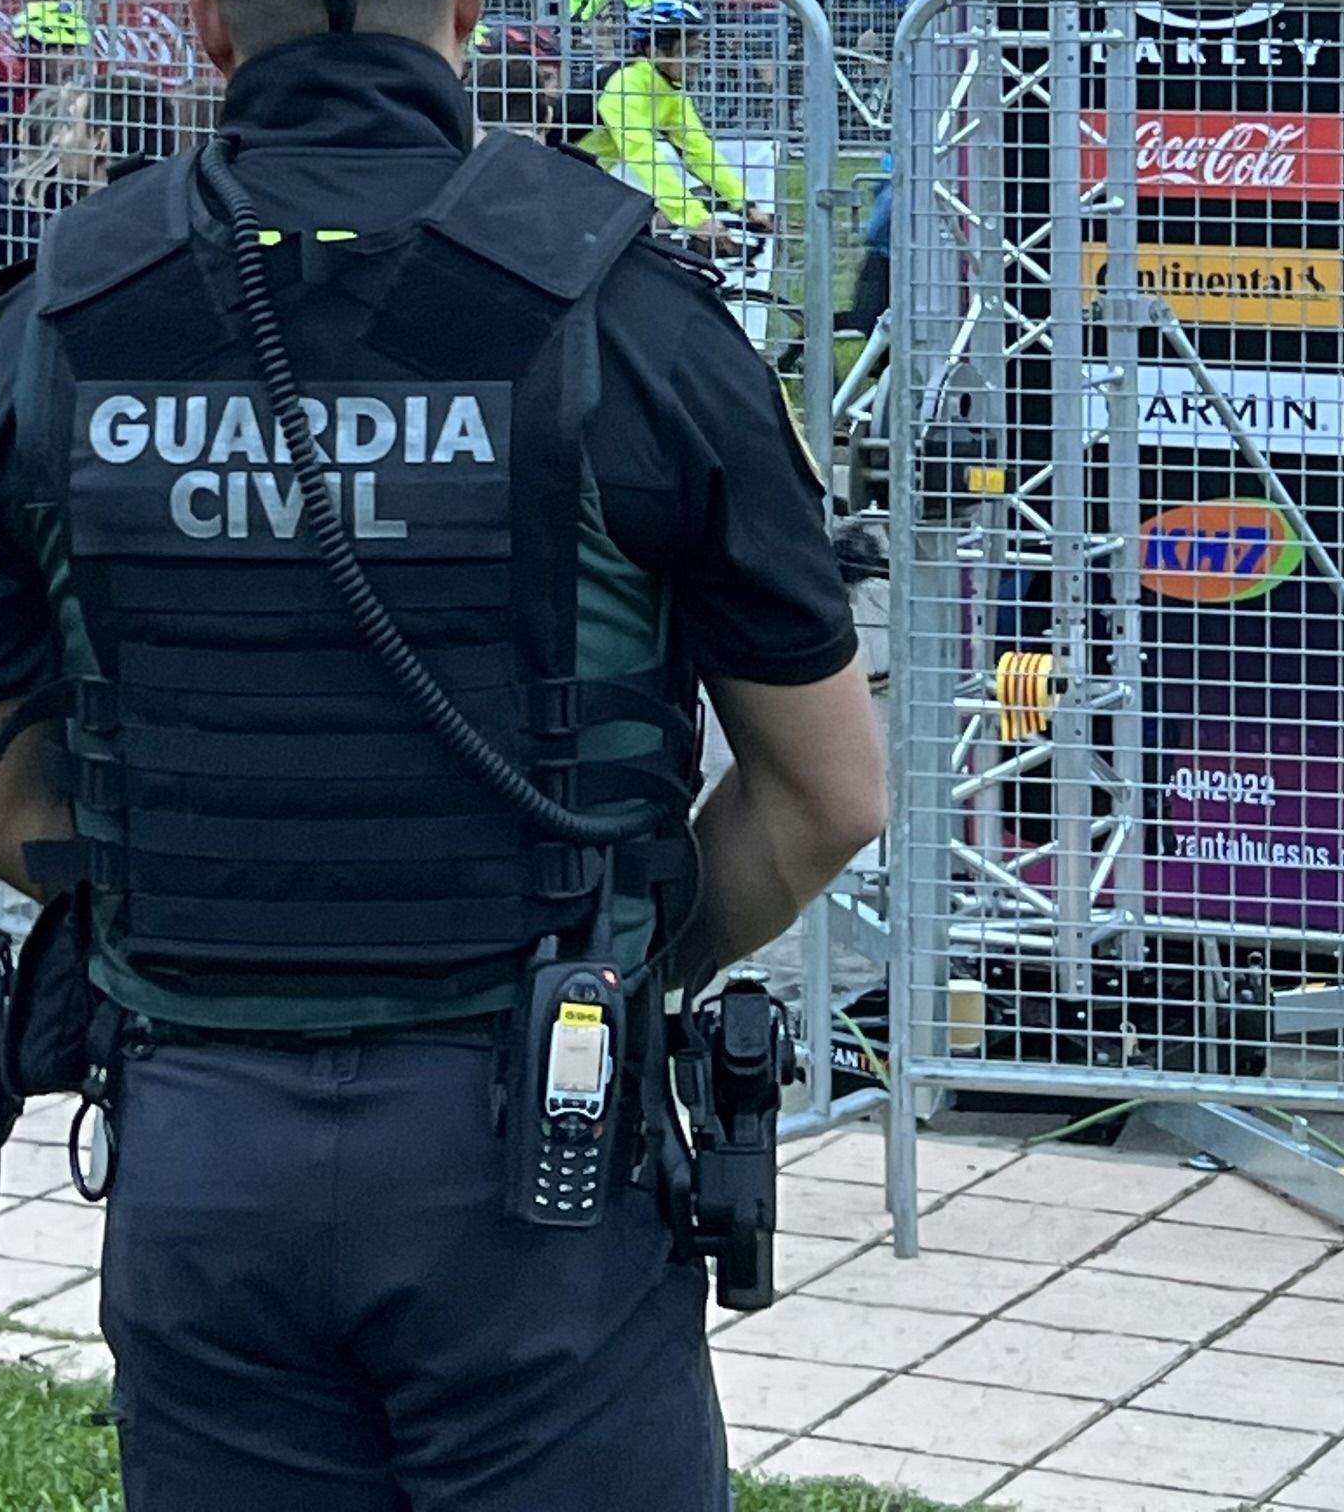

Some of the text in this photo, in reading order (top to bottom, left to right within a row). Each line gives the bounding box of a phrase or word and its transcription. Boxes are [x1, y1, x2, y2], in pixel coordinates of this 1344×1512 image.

[89, 395, 495, 464] GUARDIA
[1136, 389, 1317, 431] ARMIN
[169, 472, 408, 539] CIVIL
